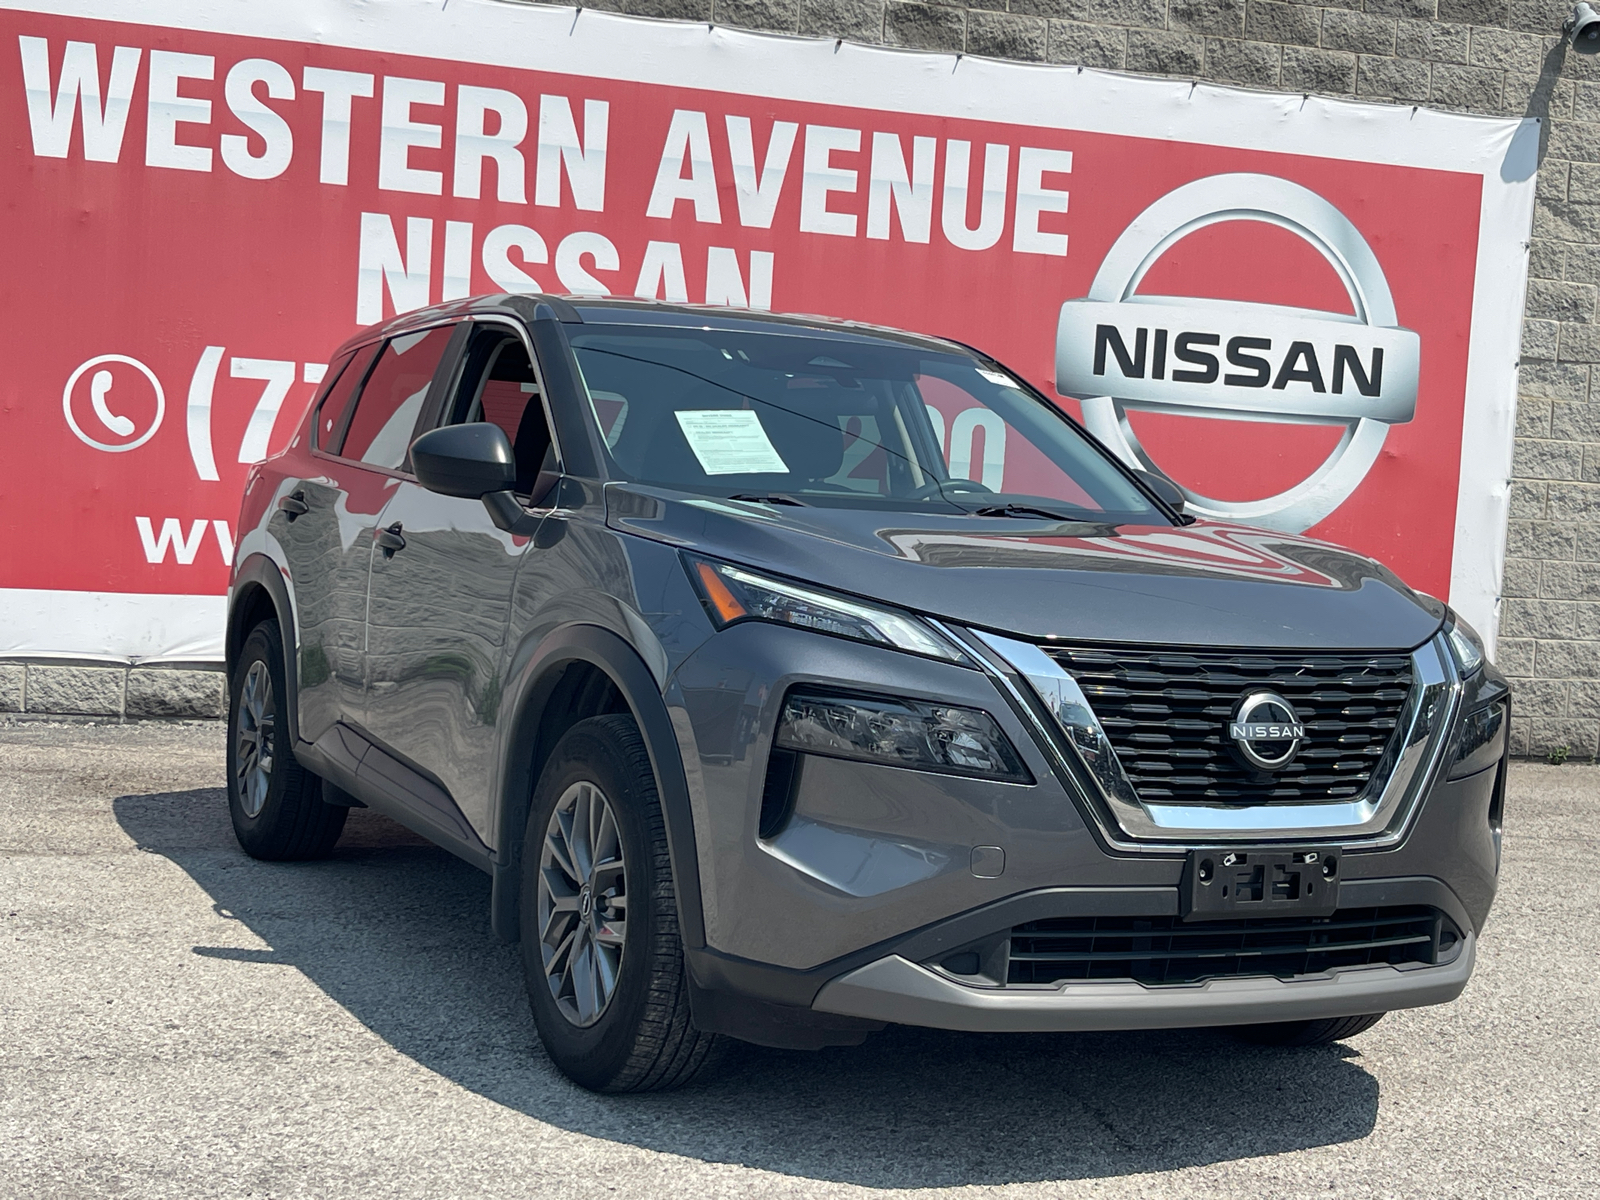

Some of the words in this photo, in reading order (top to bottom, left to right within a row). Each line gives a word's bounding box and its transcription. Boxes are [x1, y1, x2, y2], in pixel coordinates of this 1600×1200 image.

[19, 35, 609, 212] WESTERN
[646, 109, 1074, 256] AVENUE
[356, 212, 775, 325] NISSAN
[1093, 323, 1384, 397] NISSAN
[1233, 726, 1303, 737] NISSAN
